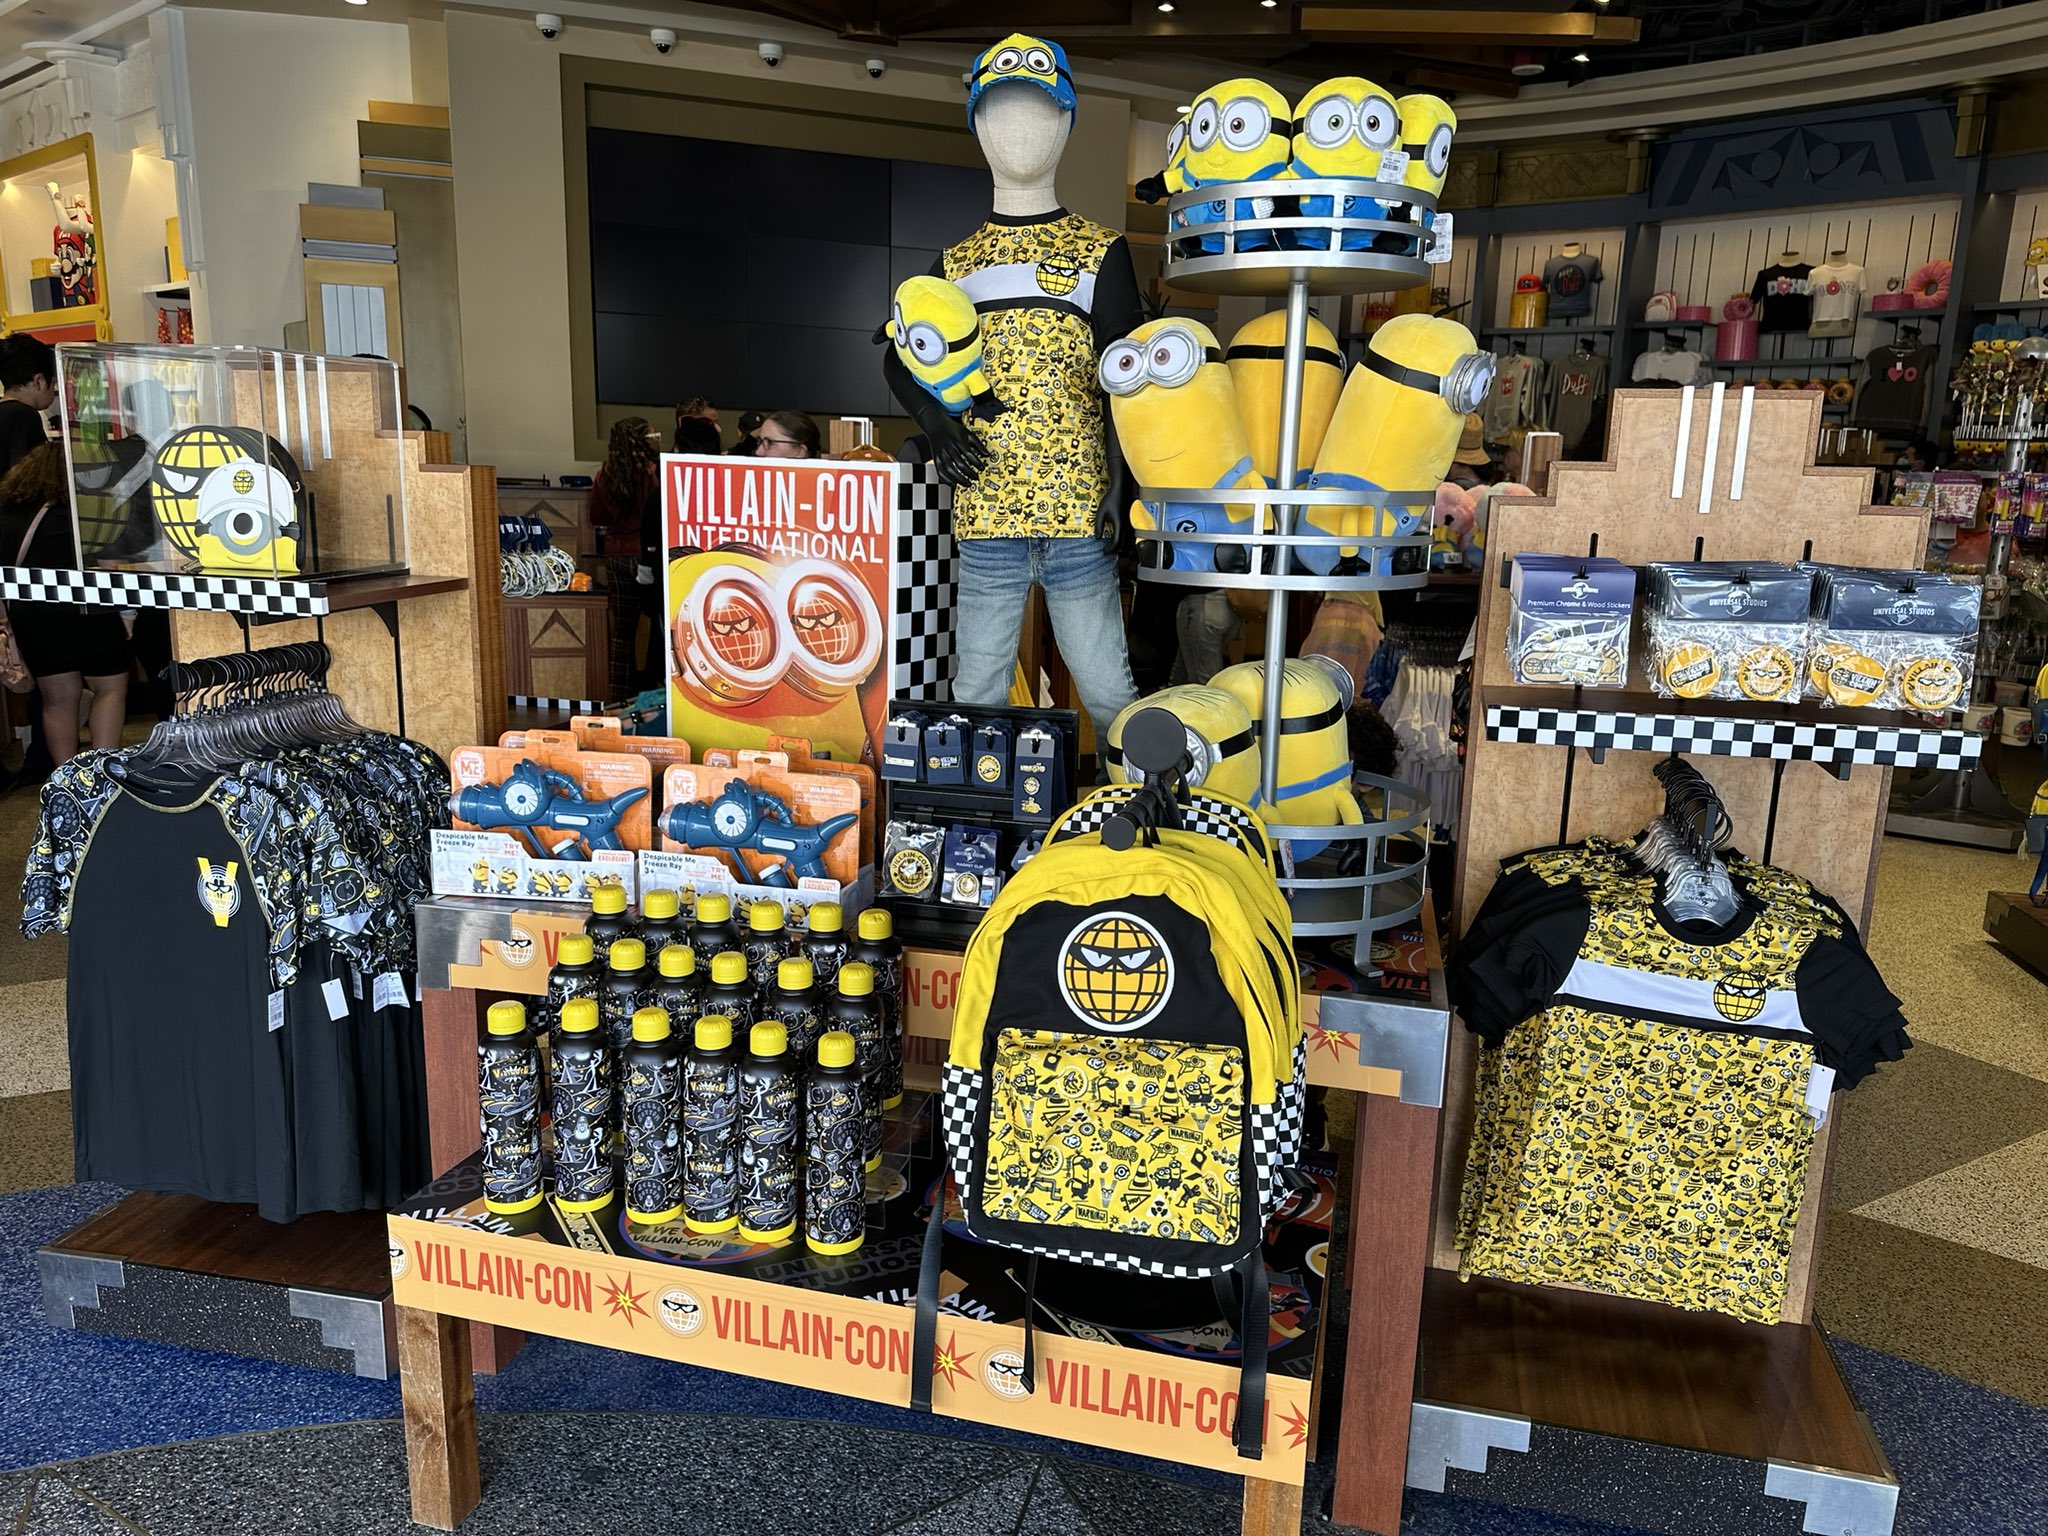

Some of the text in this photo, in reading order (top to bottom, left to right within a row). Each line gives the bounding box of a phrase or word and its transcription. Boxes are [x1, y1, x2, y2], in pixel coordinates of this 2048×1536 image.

[1562, 373, 1589, 395] Duff
[673, 466, 884, 535] VILLAIN-CON
[678, 523, 884, 564] INTERNATIONAL
[1555, 600, 1580, 608] Chrome
[1587, 601, 1606, 609] Wood
[1709, 598, 1768, 608] UNIVERSAL STUDIOS
[1873, 607, 1935, 616] UNIVERSAL STUDIOS
[1851, 674, 1880, 686] VILLAIN
[436, 832, 475, 840] Despicable
[461, 840, 475, 848] Ray
[643, 853, 682, 862] Despicable
[892, 852, 929, 872] VILLAIN-CON
[644, 860, 682, 871] Freeze Ray
[653, 1225, 680, 1236] WE
[633, 1235, 722, 1248] VILLAIN-CON!
[415, 1239, 593, 1314] VILLAIN-CON
[711, 1295, 909, 1375] VILLAIN-CON
[1045, 1357, 1270, 1445] VILLAIN-CO
